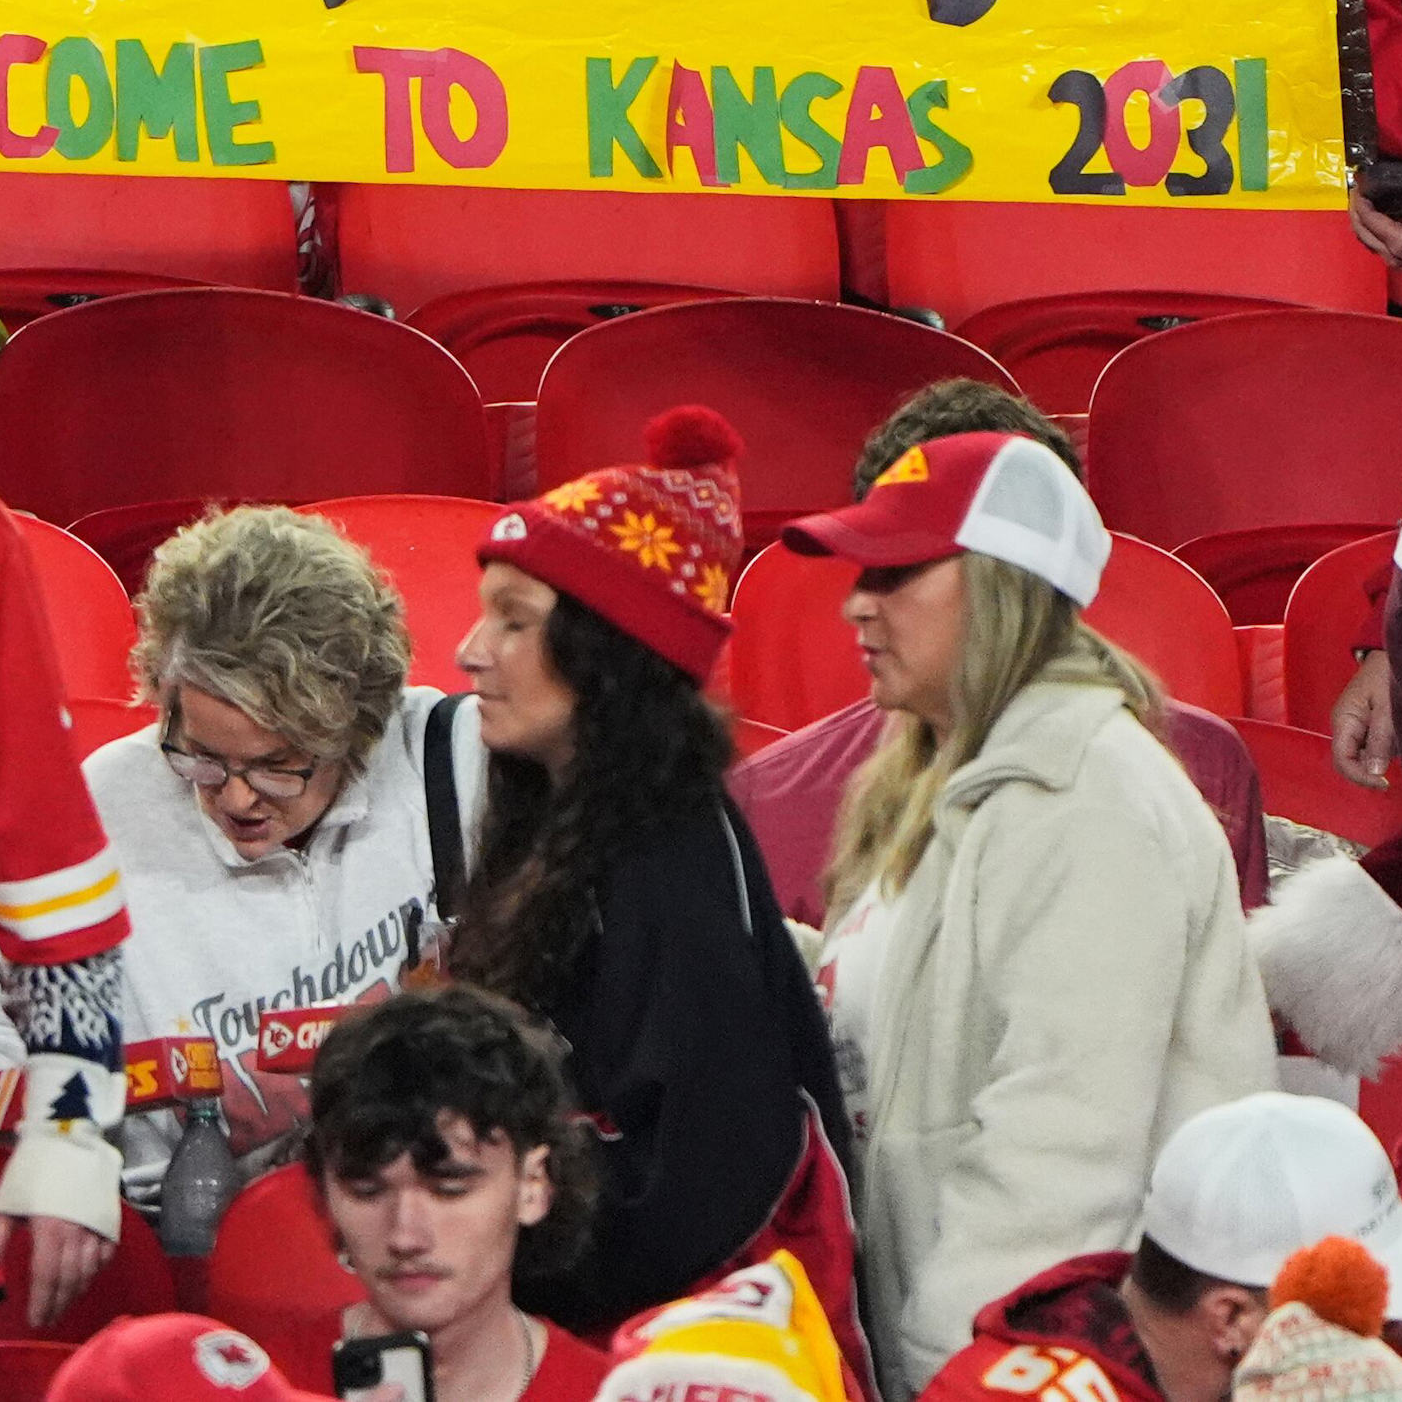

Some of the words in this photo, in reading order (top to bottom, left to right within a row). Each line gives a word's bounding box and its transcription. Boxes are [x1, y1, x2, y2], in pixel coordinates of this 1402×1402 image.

[353, 46, 509, 174] TO
[586, 56, 973, 194] KANSAS
[1048, 57, 1268, 196] 2031
